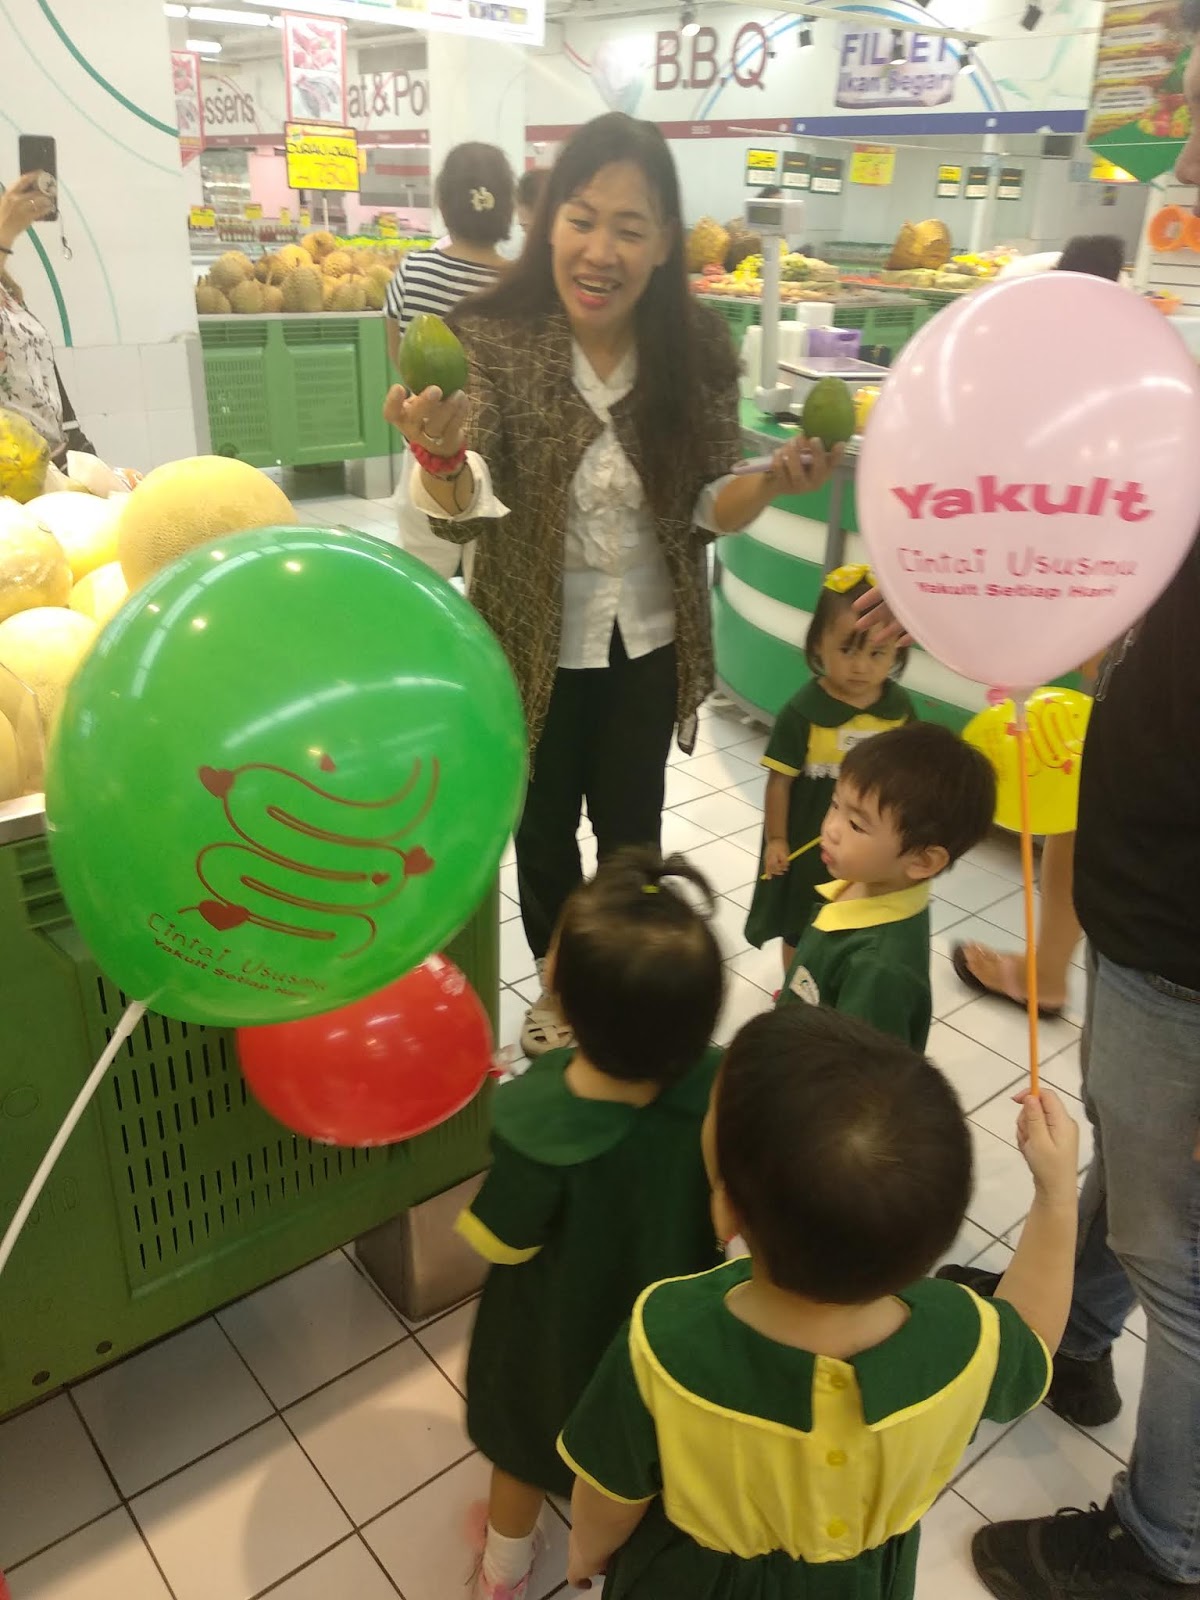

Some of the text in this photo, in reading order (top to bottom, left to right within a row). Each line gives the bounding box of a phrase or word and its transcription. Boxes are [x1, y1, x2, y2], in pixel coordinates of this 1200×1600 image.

[654, 21, 766, 91] B.B.Q
[841, 31, 952, 66] FILET
[889, 475, 1155, 523] Yakult
[897, 548, 986, 575] Cintai
[148, 912, 231, 962] Cintai
